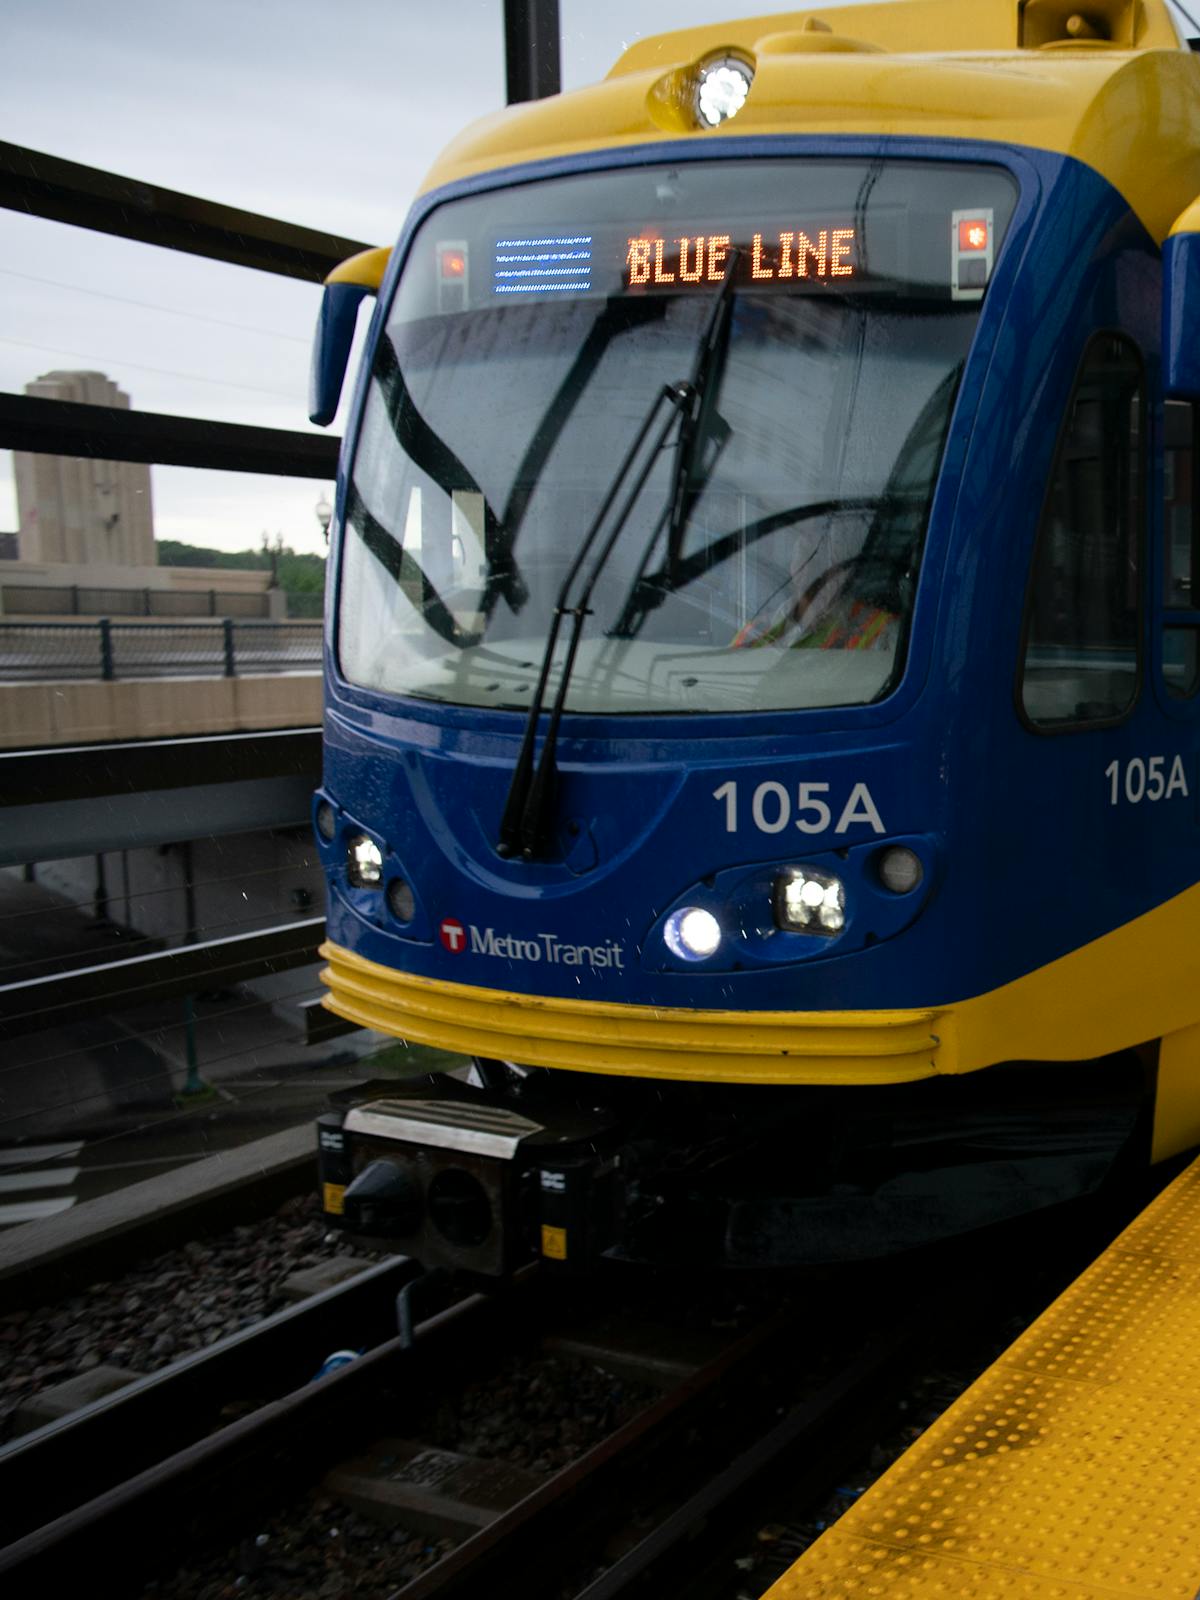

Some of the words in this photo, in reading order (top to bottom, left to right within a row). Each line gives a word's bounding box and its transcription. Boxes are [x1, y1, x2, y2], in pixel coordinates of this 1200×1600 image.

[628, 235, 730, 284] BLUE
[752, 229, 854, 278] LINE
[1105, 755, 1188, 805] 105A
[712, 781, 886, 834] 105A
